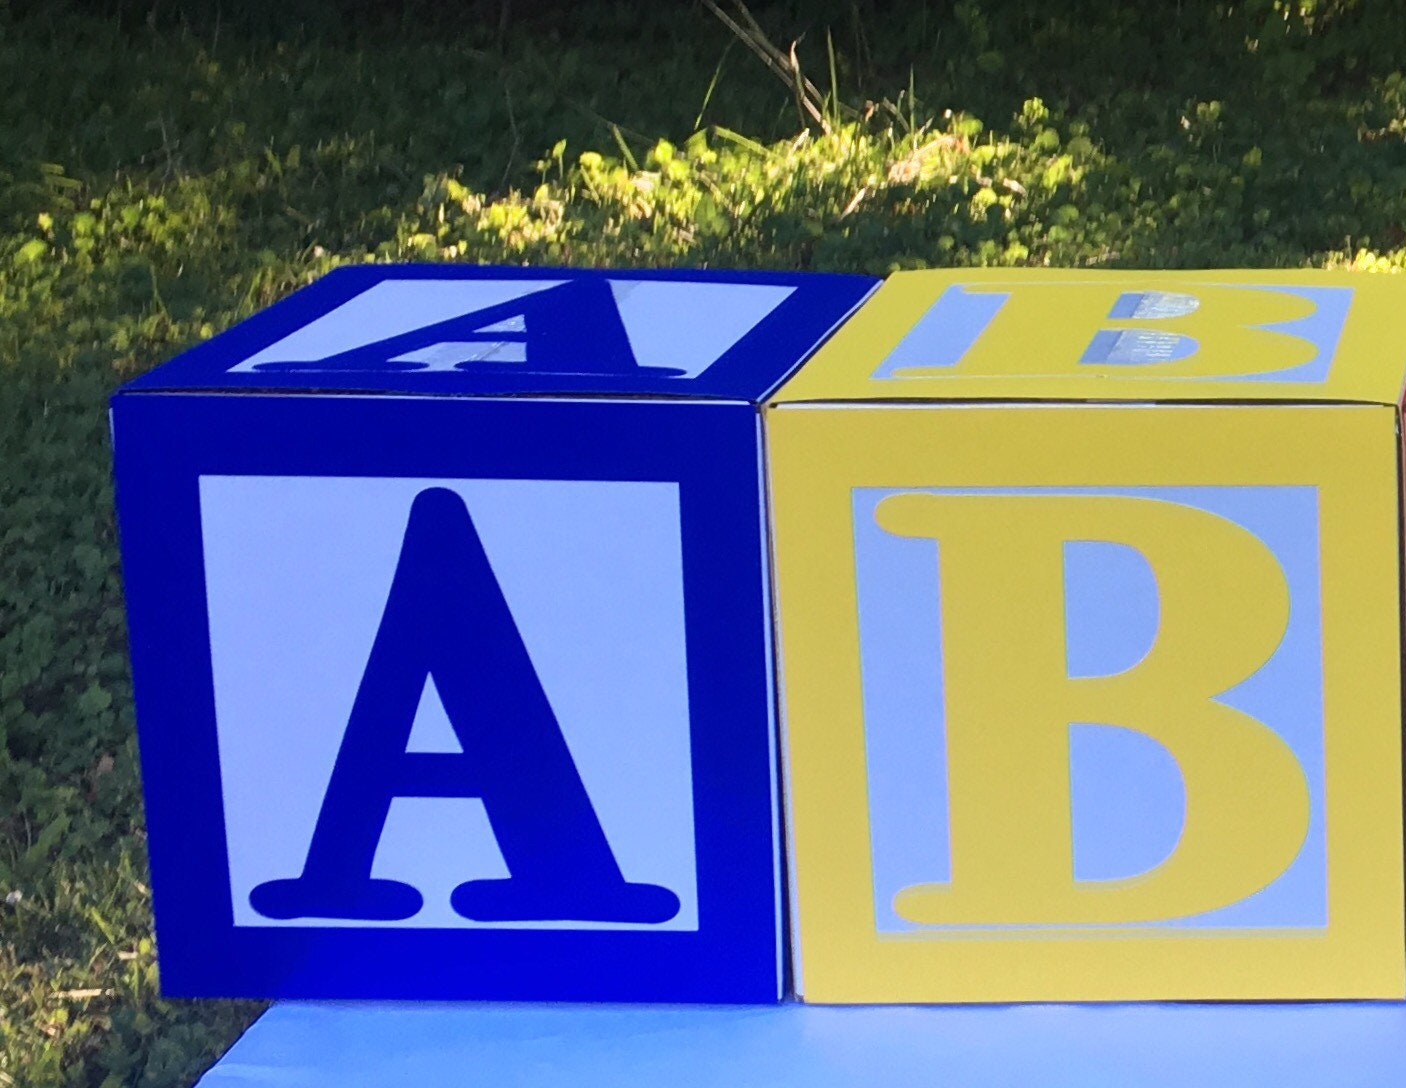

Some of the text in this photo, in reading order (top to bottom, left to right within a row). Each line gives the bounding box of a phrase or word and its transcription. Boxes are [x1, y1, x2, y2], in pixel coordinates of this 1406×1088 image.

[253, 279, 688, 375] A
[890, 283, 1319, 377] B
[248, 486, 681, 924] A
[873, 492, 1311, 925] B
